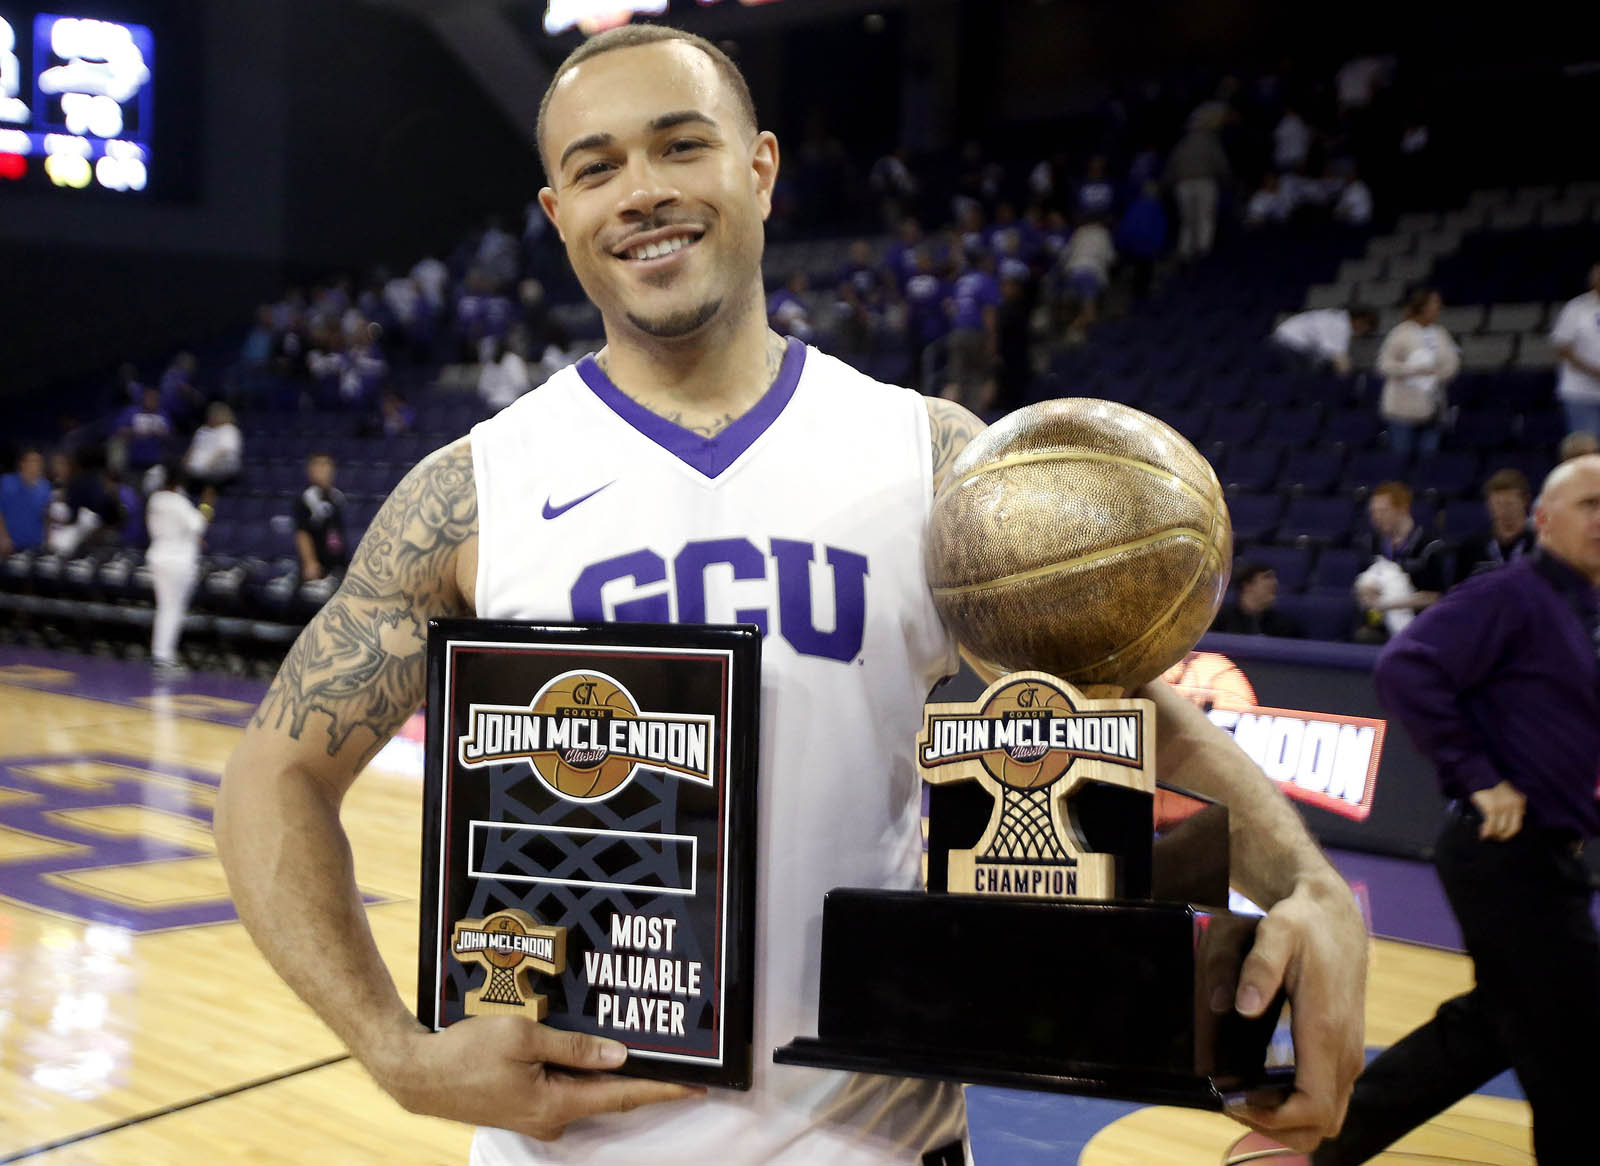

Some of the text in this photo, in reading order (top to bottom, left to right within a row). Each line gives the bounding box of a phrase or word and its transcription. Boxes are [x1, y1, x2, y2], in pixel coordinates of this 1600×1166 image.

[569, 536, 870, 665] GCU
[563, 708, 605, 718] COACH
[1009, 710, 1046, 718] COACH
[466, 713, 706, 772] JOHN MCLENDON
[564, 747, 607, 763] Classic
[925, 716, 1138, 760] JOHN MCLENDON
[975, 868, 1077, 895] CHAMPION
[456, 931, 553, 959] JOHN MCLENDON
[611, 913, 677, 951] MOST
[584, 951, 701, 996] VALUABLE
[597, 993, 685, 1037] PLAYER
